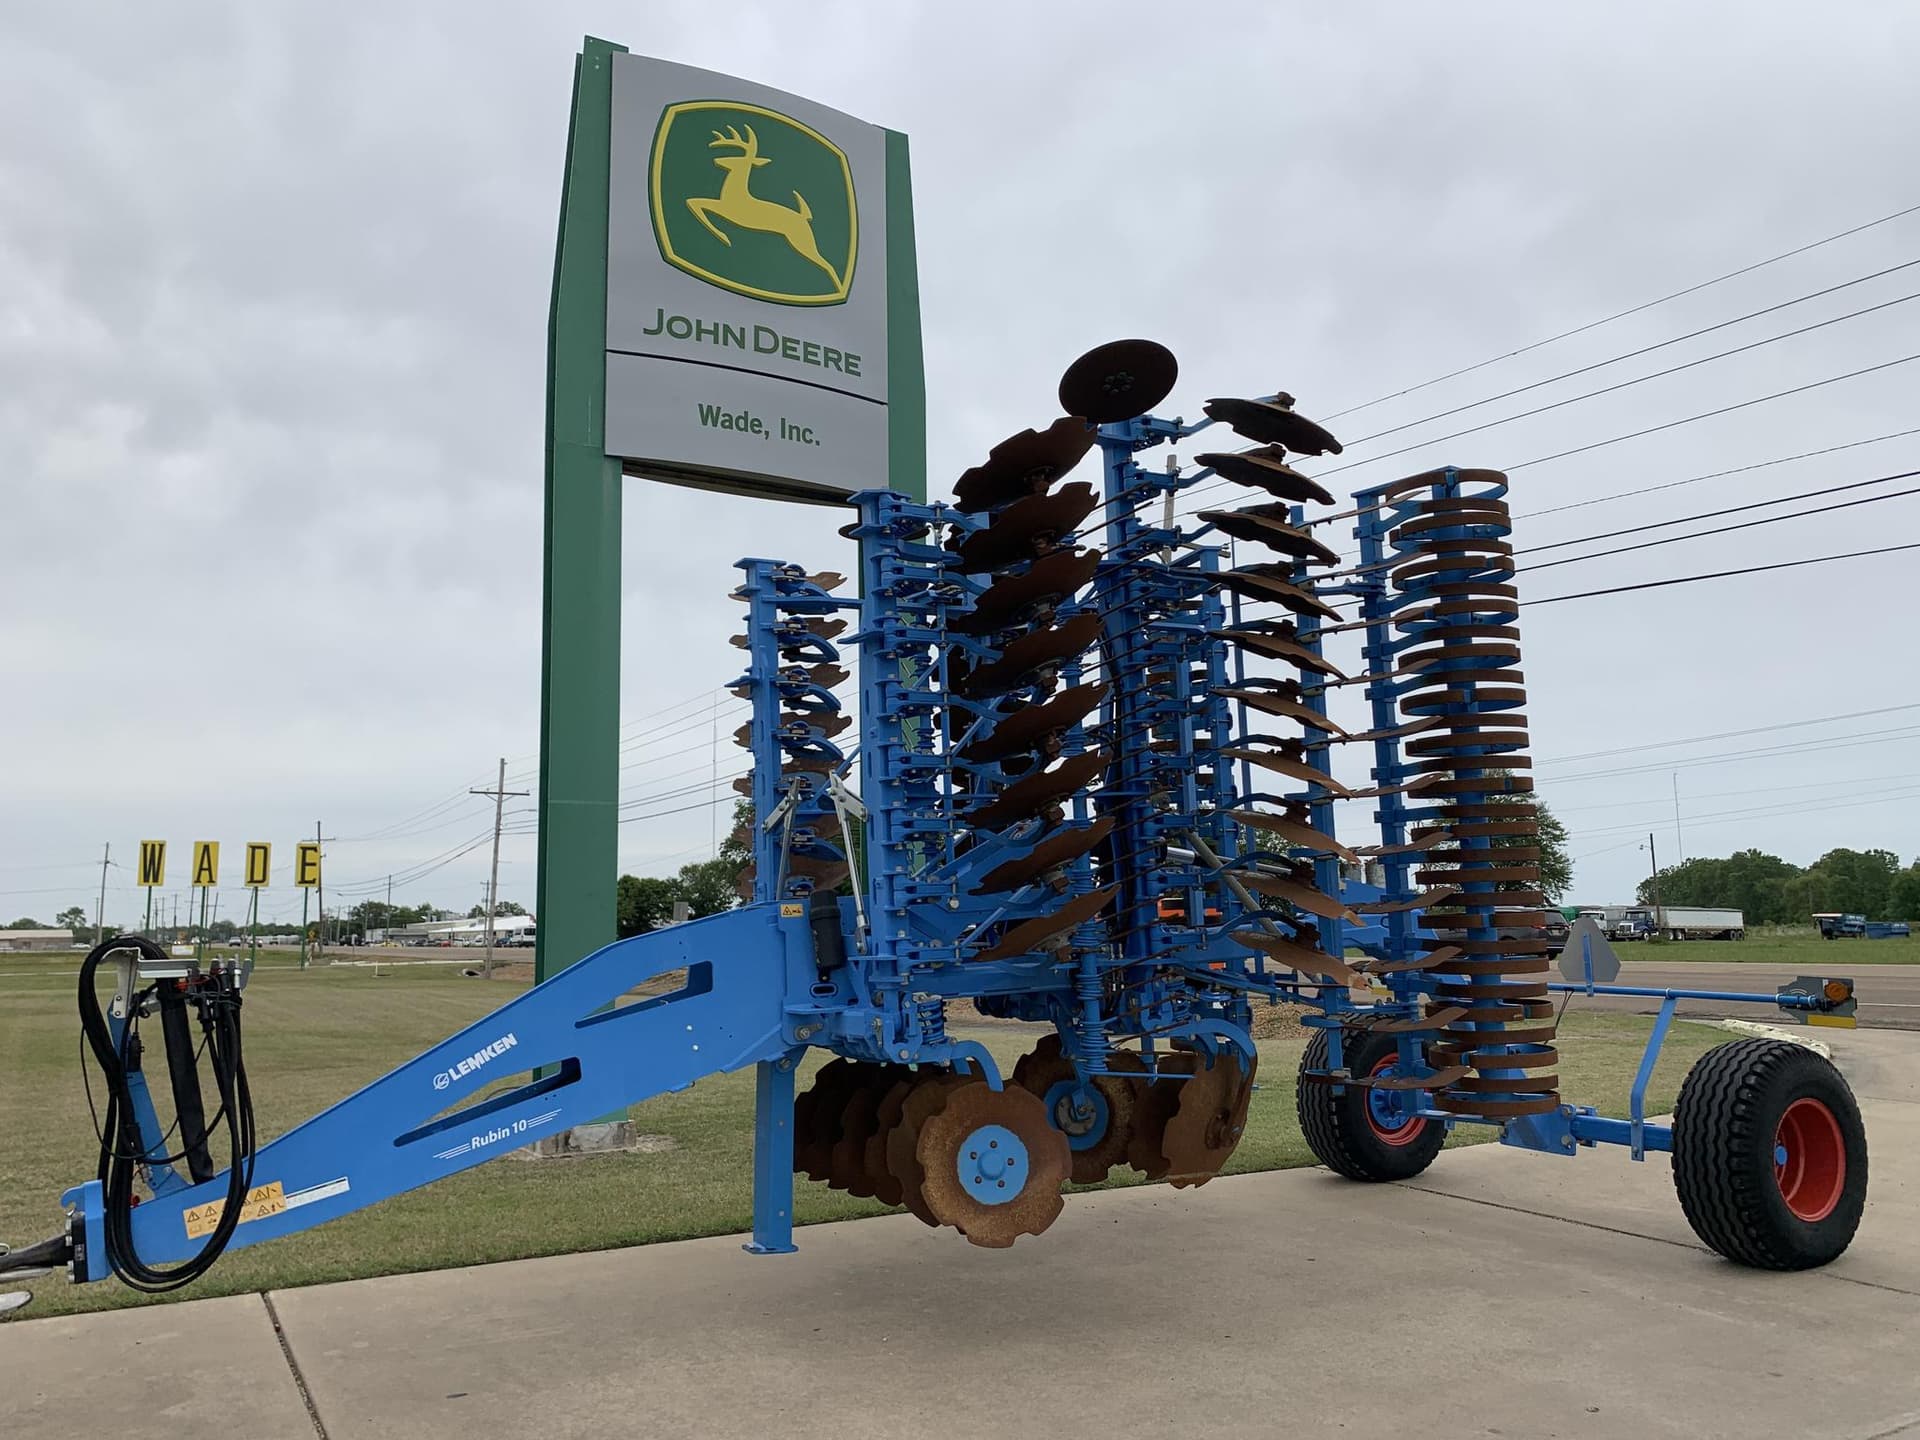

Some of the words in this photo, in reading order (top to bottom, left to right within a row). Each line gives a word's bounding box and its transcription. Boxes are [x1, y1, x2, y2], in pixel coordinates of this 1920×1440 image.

[643, 308, 746, 349] JOHN
[754, 325, 862, 377] DEERE
[698, 403, 770, 440] Wade,
[780, 417, 820, 446] Inc.
[448, 1033, 518, 1081] LEMKEN
[471, 1127, 510, 1150] Rubin
[512, 1119, 527, 1134] 10
